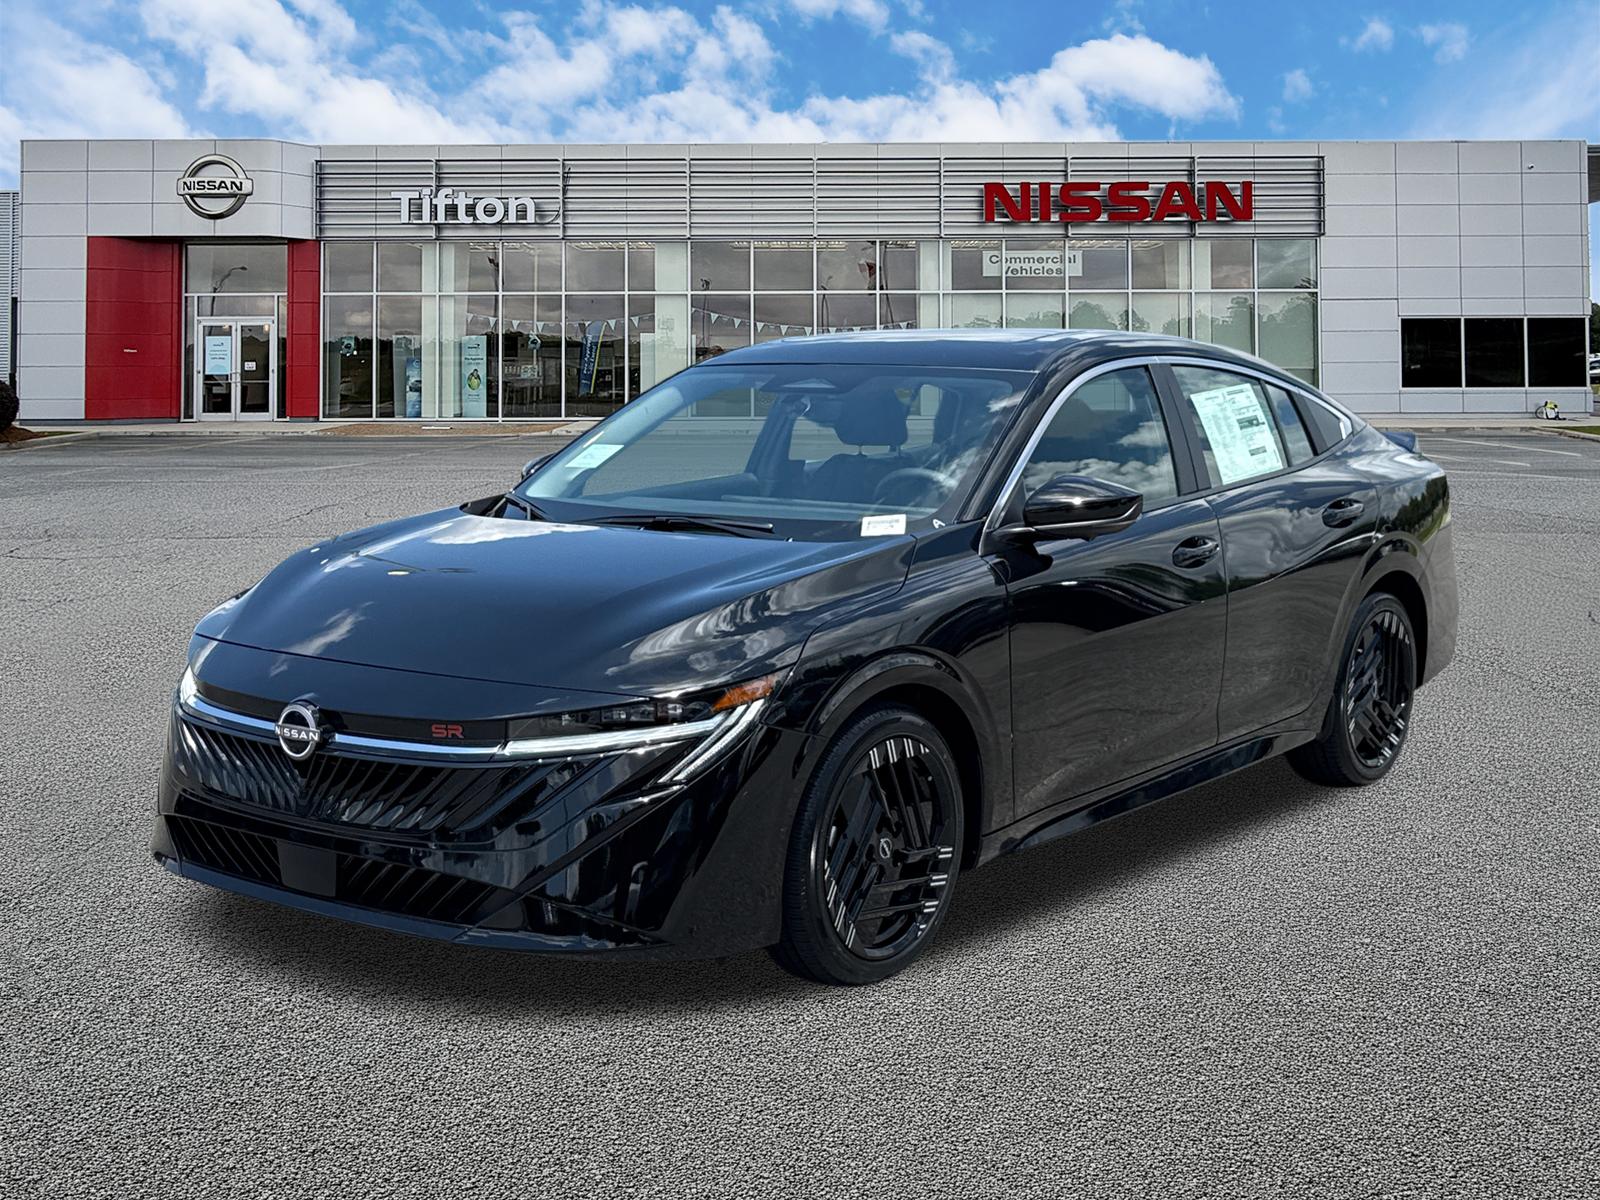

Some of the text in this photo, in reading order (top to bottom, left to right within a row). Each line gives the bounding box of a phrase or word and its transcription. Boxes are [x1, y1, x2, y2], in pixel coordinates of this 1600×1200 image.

[182, 180, 243, 191] NISSAN
[391, 188, 536, 224] Tifton
[984, 181, 1253, 222] NISSAN
[275, 725, 319, 741] NISSAN
[431, 724, 464, 739] SR
